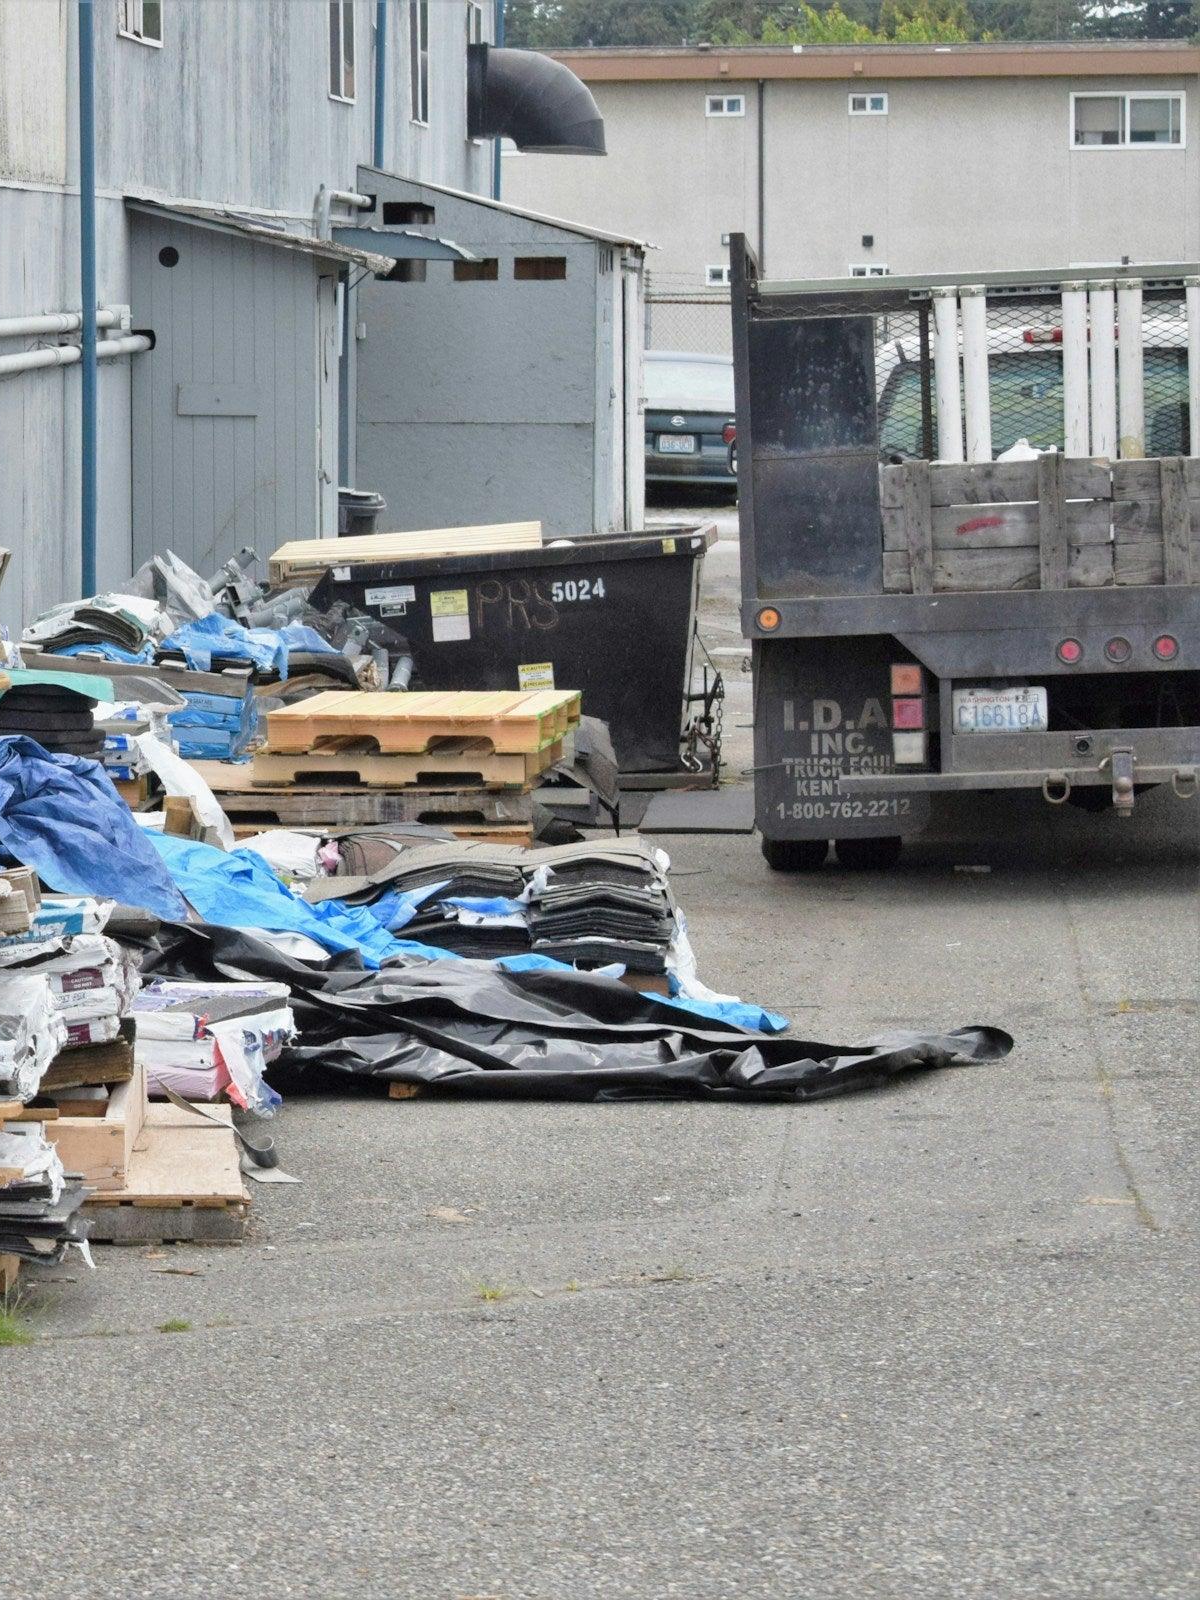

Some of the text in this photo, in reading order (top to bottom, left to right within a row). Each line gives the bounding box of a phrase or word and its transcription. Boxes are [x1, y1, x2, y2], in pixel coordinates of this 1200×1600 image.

[551, 578, 606, 602] 5024
[960, 695, 1010, 704] WASHINGTON
[810, 732, 874, 755] INC.
[781, 757, 843, 778] TRUCK
[776, 798, 912, 820] 1-800-762-2212
